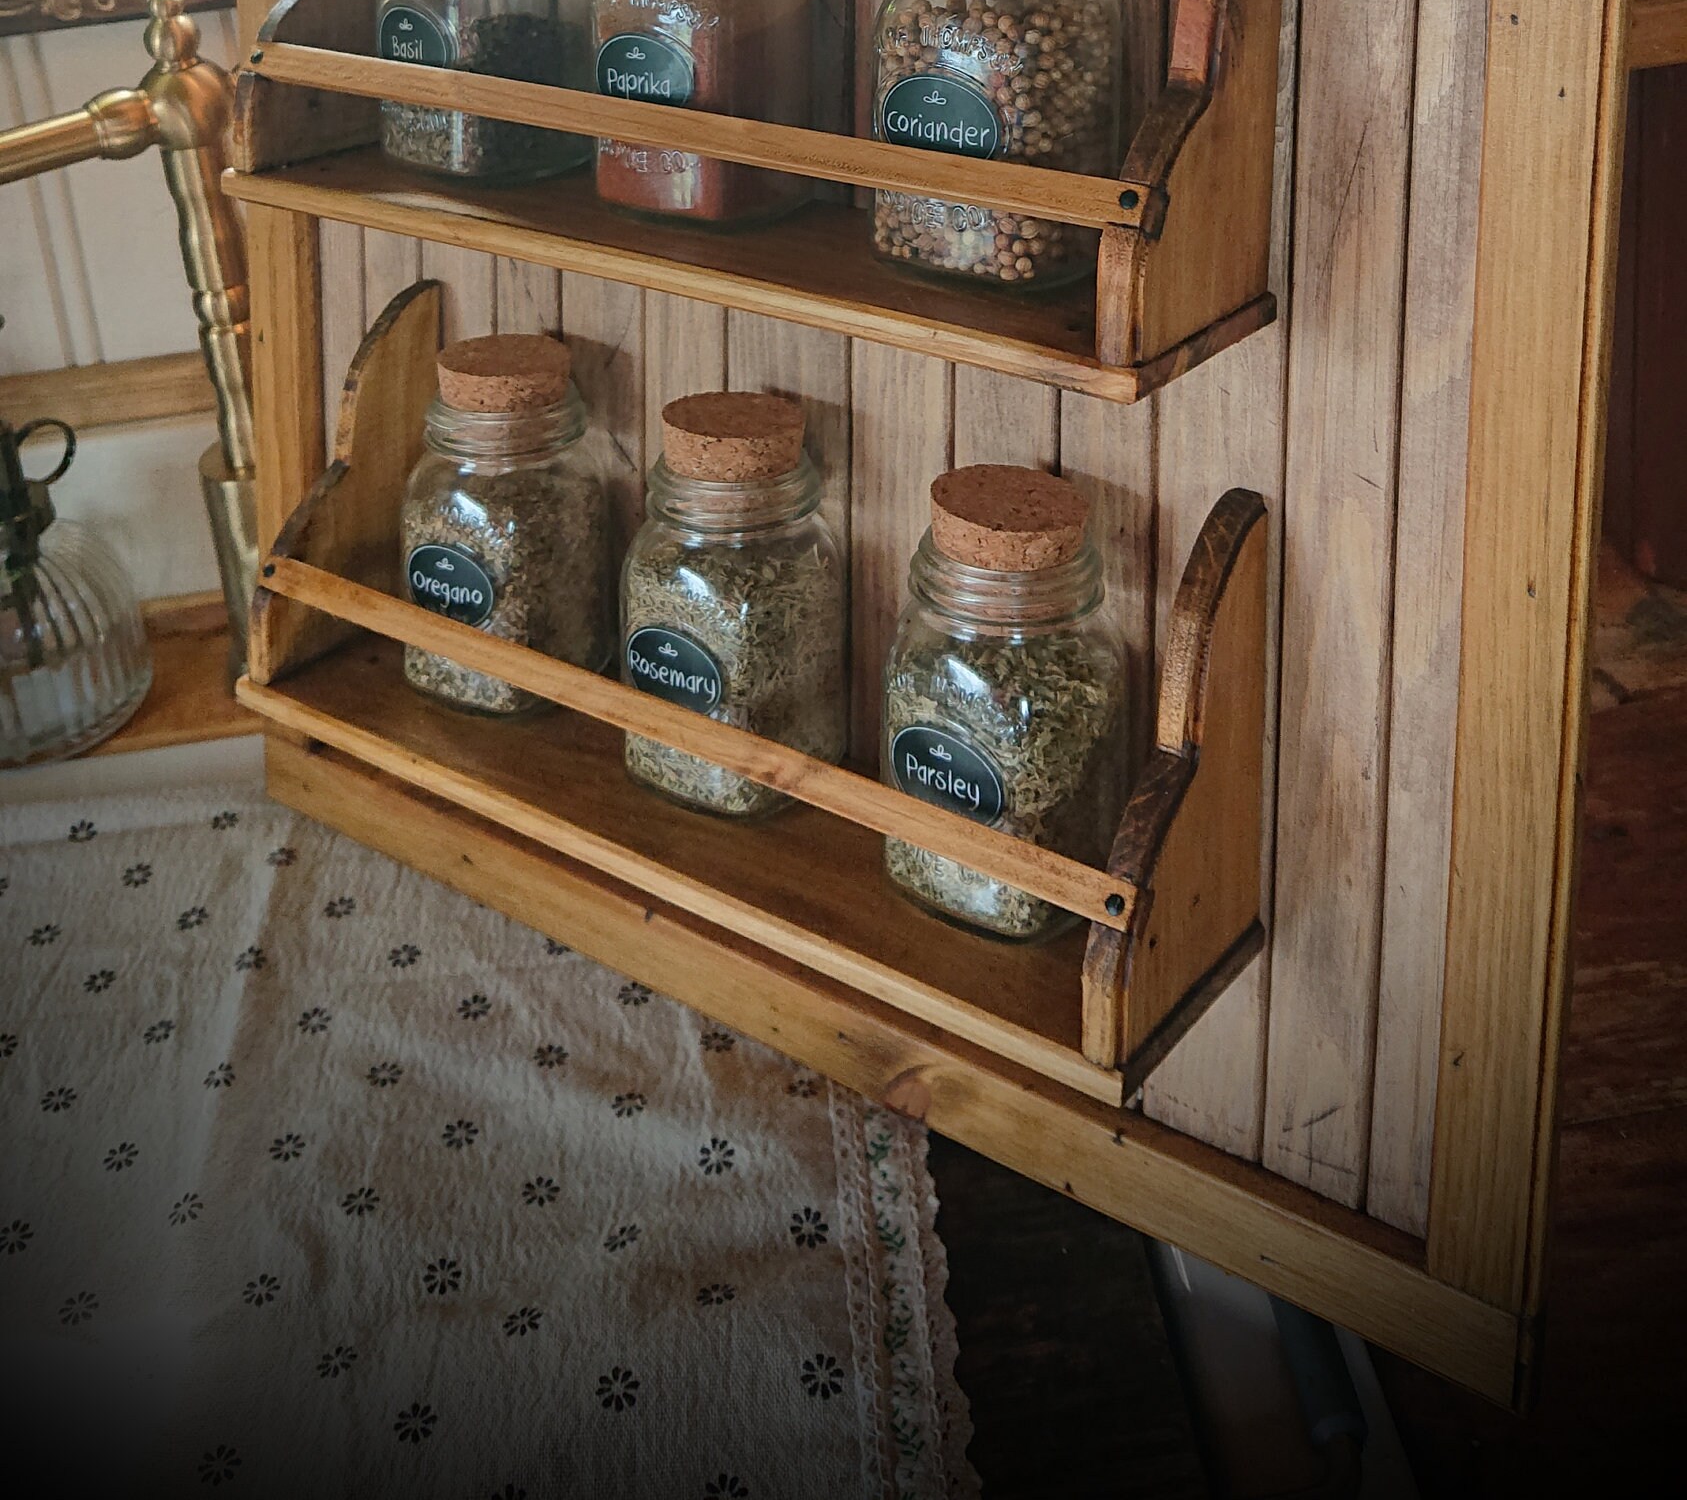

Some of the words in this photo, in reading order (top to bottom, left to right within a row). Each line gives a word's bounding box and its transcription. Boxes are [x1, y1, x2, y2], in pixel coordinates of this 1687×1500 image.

[391, 35, 423, 61] Basil
[607, 67, 671, 100] Paprika
[413, 570, 484, 609] Oregano
[630, 649, 716, 704] Rosemary
[906, 752, 980, 812] Parsley
